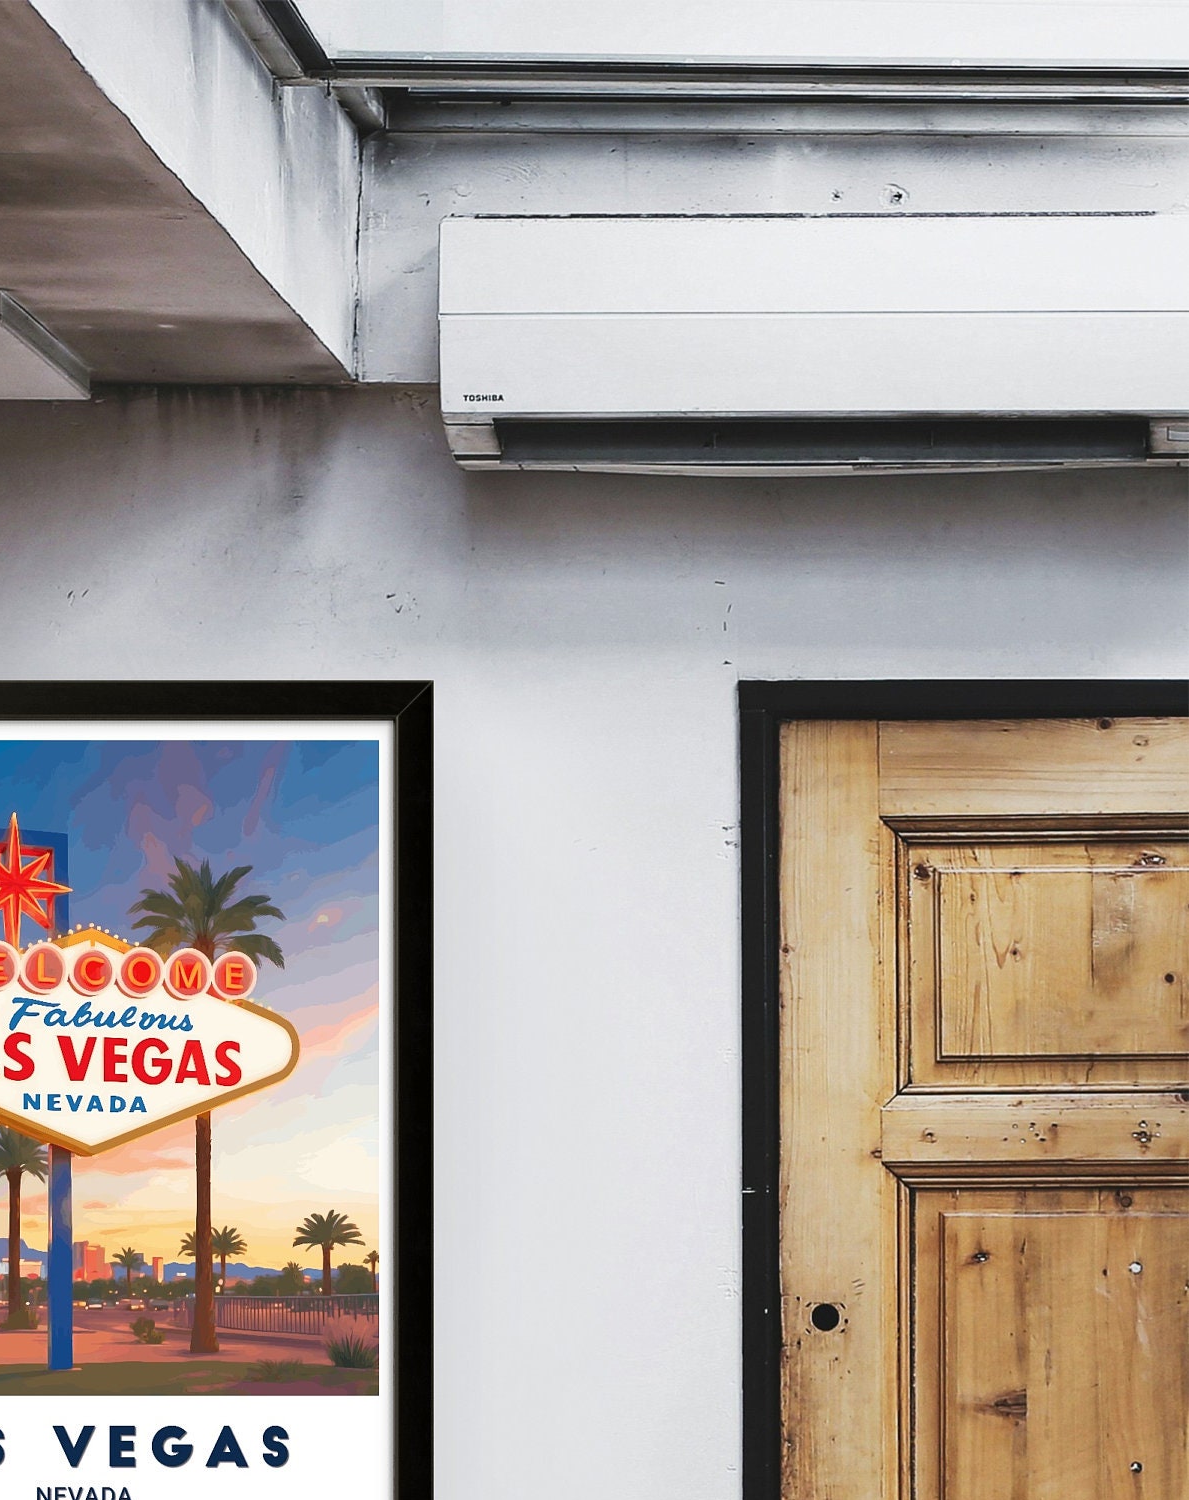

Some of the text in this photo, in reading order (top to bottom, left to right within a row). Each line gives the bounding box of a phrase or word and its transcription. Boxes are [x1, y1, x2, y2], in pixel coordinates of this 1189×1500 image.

[463, 394, 504, 402] TOSHIBA
[10, 997, 194, 1032] Fabulous
[57, 1035, 242, 1087] VEGAS
[23, 1093, 147, 1113] NEVADA
[52, 1425, 289, 1468] VEGAS
